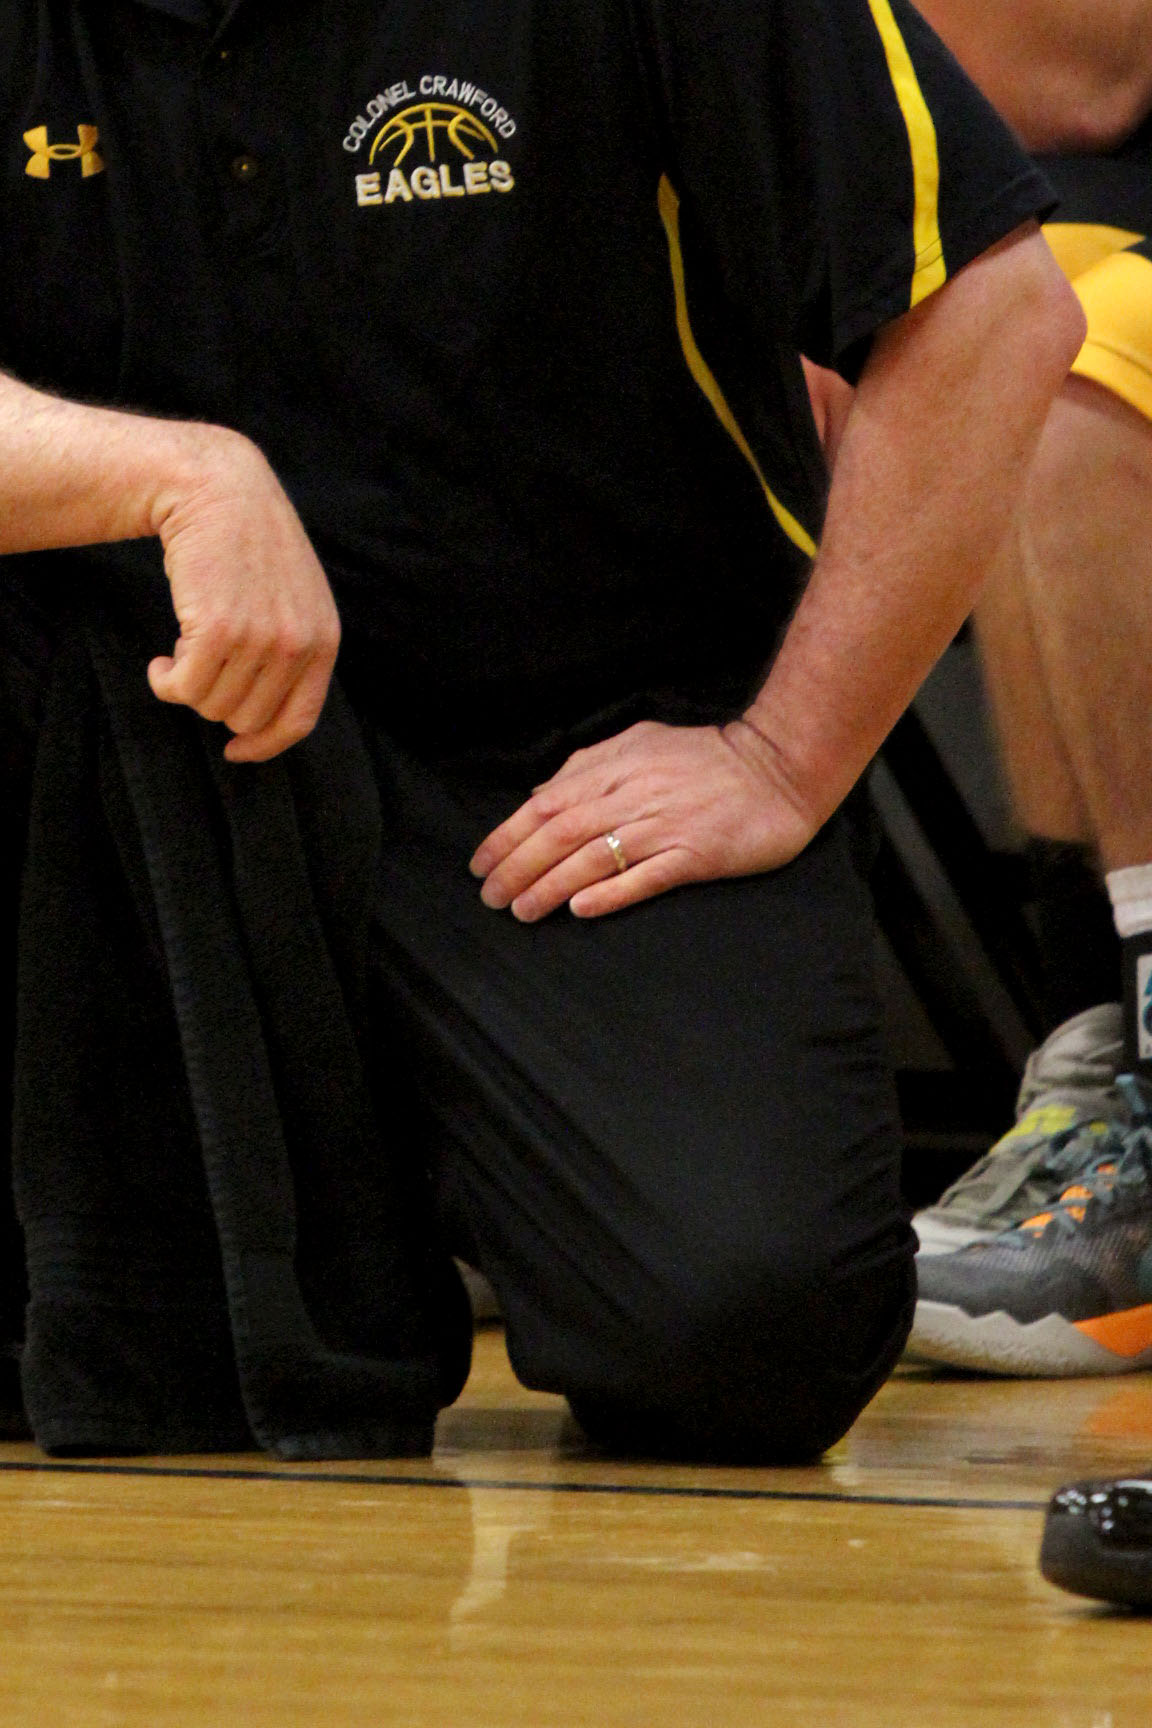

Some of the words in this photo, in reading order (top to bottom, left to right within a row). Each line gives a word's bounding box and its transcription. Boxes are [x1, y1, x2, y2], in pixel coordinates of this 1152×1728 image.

[342, 80, 417, 153] COLONEL
[419, 75, 517, 139] CRAWFORD
[354, 160, 516, 207] EAGLES
